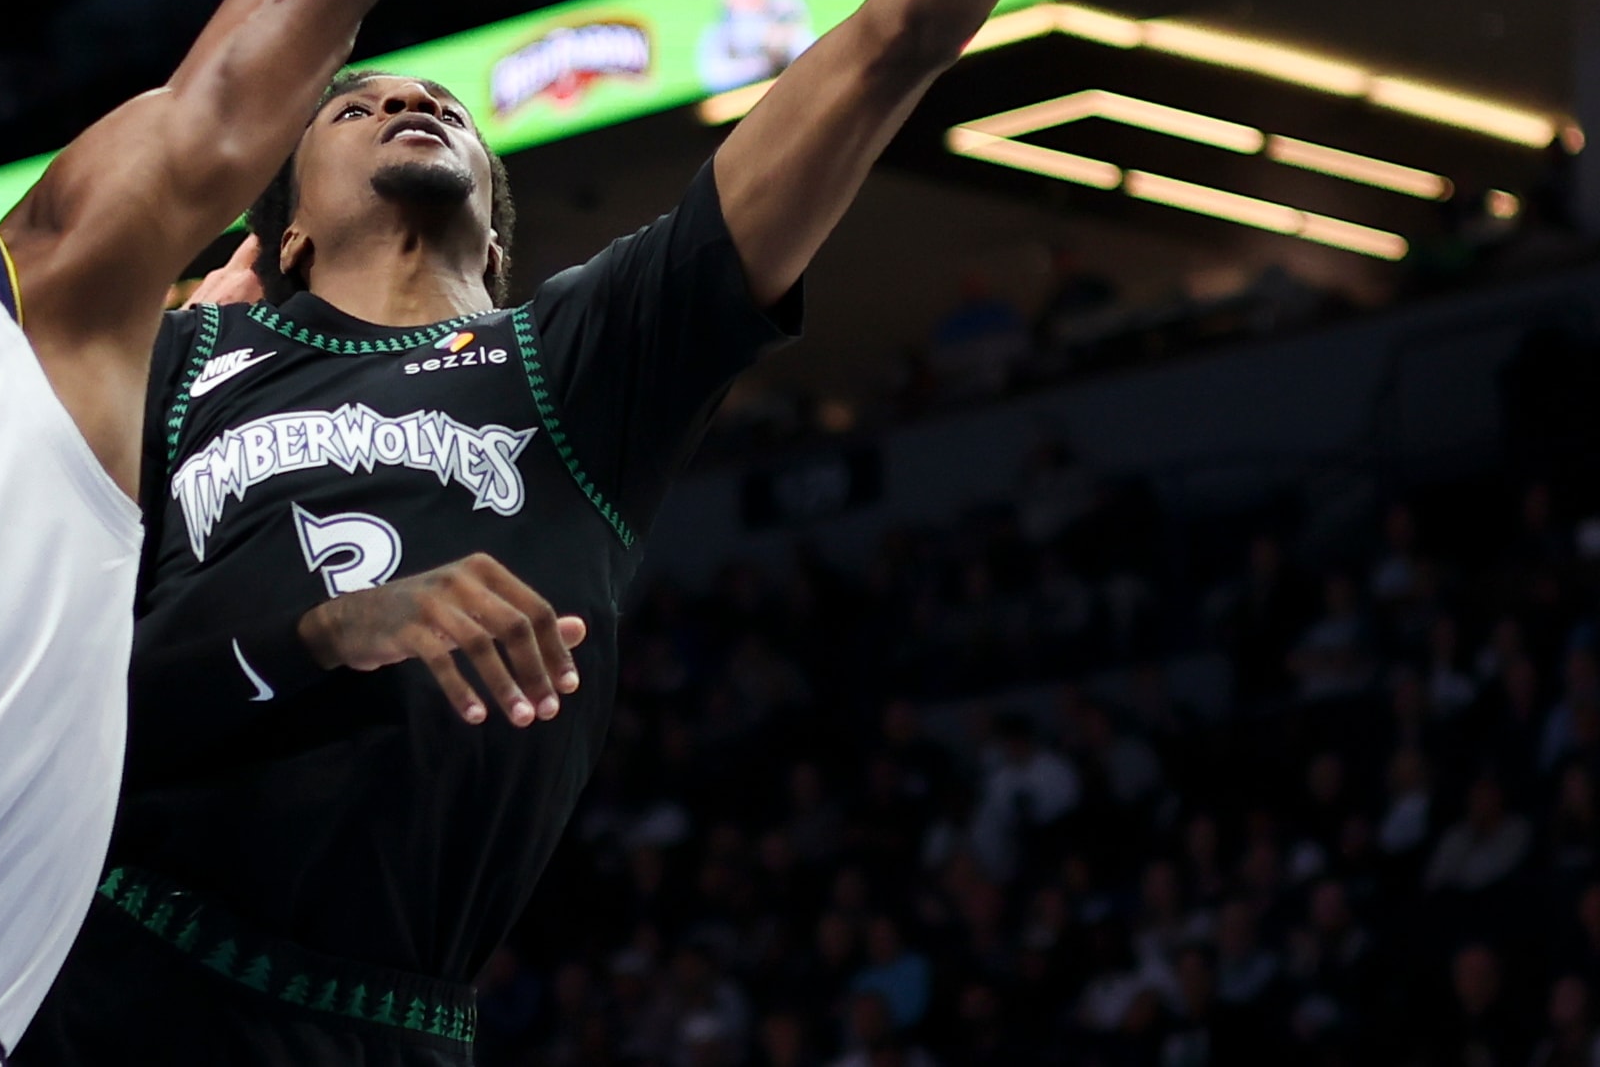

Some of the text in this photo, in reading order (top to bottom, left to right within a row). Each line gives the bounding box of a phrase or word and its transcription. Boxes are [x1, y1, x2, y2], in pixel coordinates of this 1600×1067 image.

[202, 348, 254, 382] NIKE
[404, 346, 508, 375] sezzle
[171, 402, 538, 563] TIMBERWOLVES
